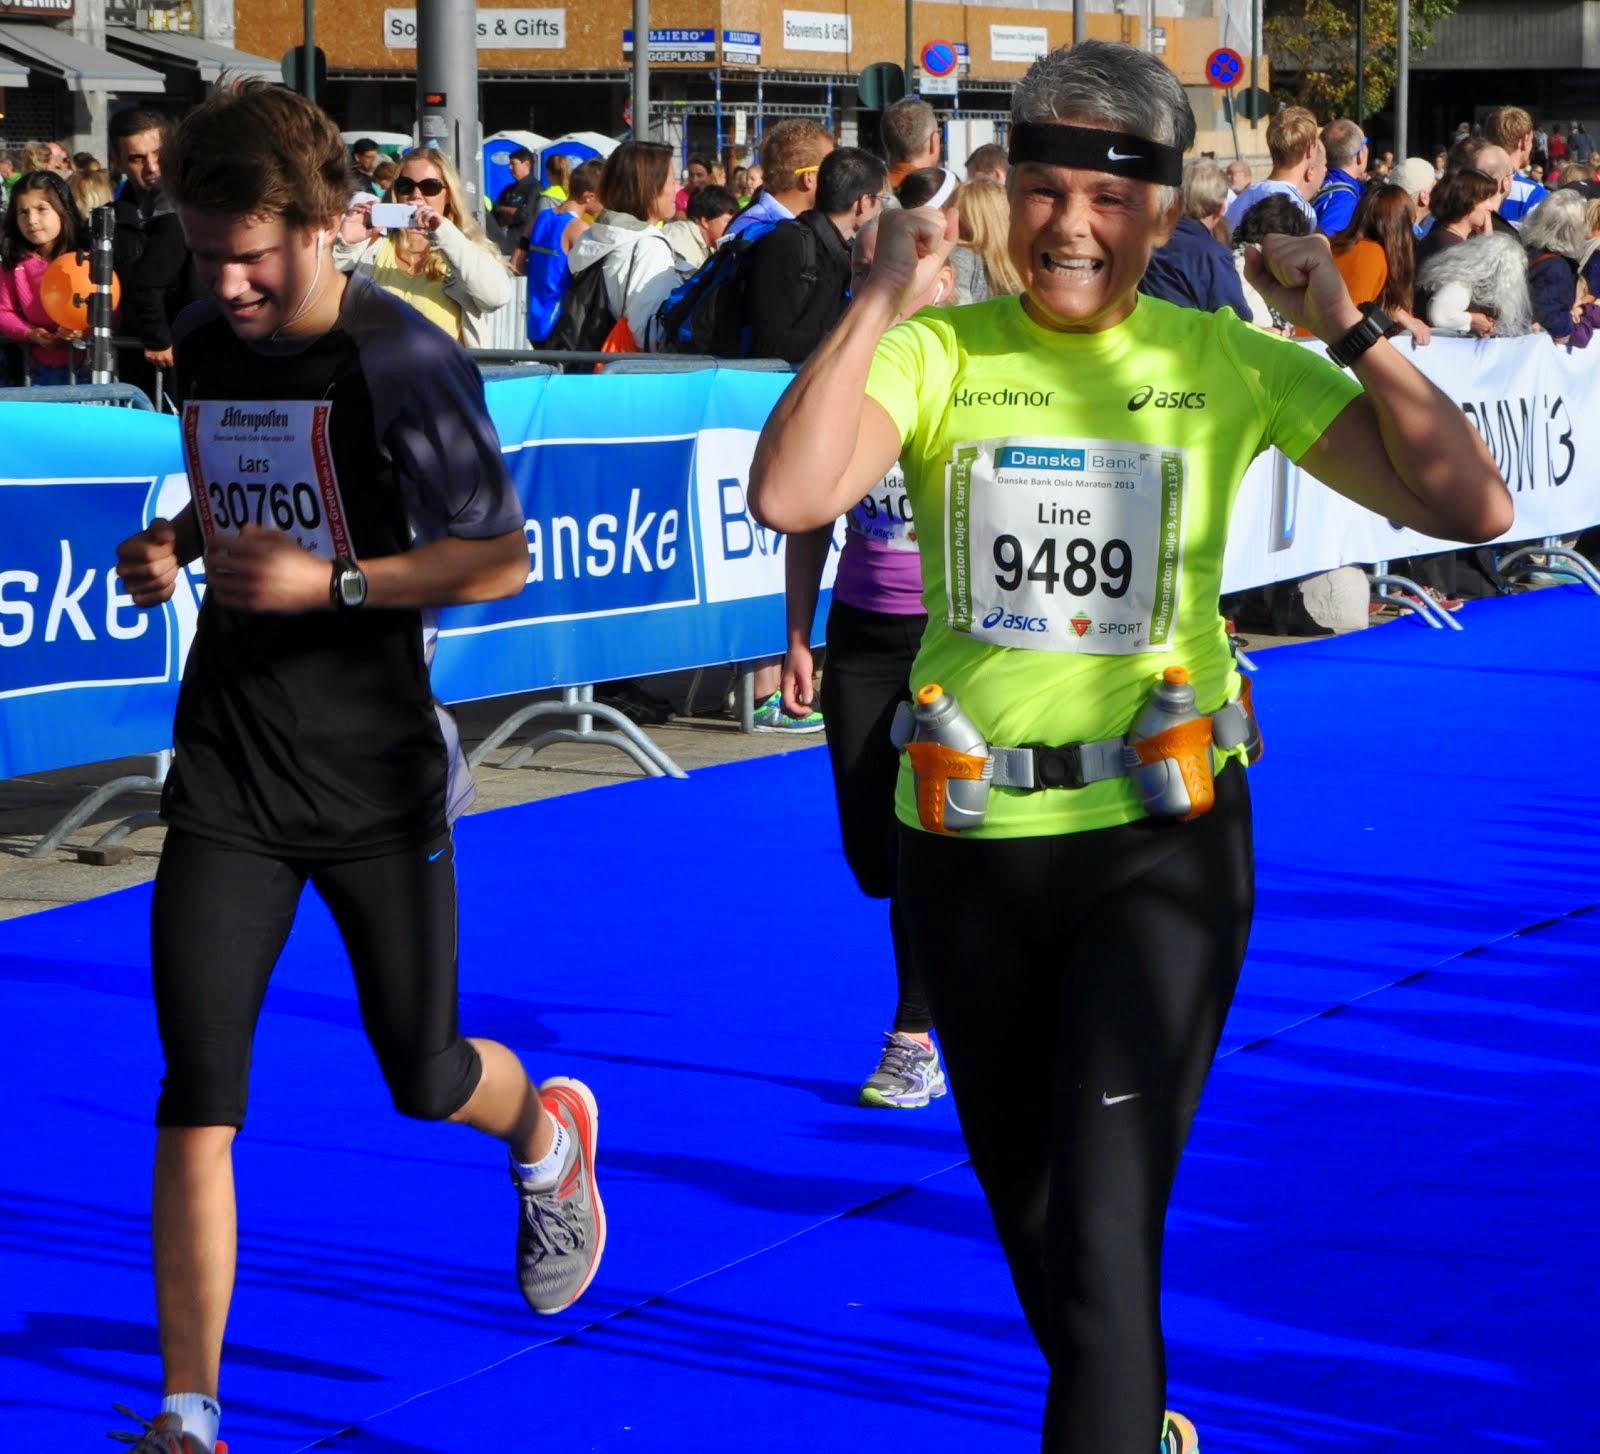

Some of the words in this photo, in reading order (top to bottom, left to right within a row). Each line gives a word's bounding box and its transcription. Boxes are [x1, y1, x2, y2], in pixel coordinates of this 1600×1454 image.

[494, 19, 507, 35] &
[515, 19, 559, 35] Gifts
[649, 31, 700, 41] LLIERO
[785, 20, 823, 39] Souvenirs
[824, 23, 830, 39] &
[648, 52, 706, 62] GGEPLASS
[1462, 396, 1536, 492] MW
[1545, 394, 1576, 488] i3
[238, 455, 270, 473] Lars
[1011, 451, 1081, 468] Danske
[1092, 455, 1136, 470] Bank
[997, 476, 1029, 486] Danske
[1030, 477, 1052, 486] Bank
[1054, 478, 1073, 487] Oslo
[1075, 479, 1112, 489] Maraton
[1114, 480, 1135, 490] 2013
[209, 482, 321, 530] 30760
[326, 488, 339, 520] Grete
[955, 484, 966, 506] start
[1168, 493, 1177, 516] start
[955, 510, 965, 519] 9,
[1038, 502, 1092, 526] Line
[1166, 518, 1177, 529] 9,
[524, 488, 679, 584] anske
[955, 521, 967, 547] Pulje
[1164, 532, 1177, 559] Pulje
[993, 534, 1133, 599] 9489
[0, 539, 149, 648] ske
[955, 550, 968, 623] Halvmaraton
[1154, 562, 1173, 636] Halvmaraton
[1098, 622, 1143, 635] SPORT
